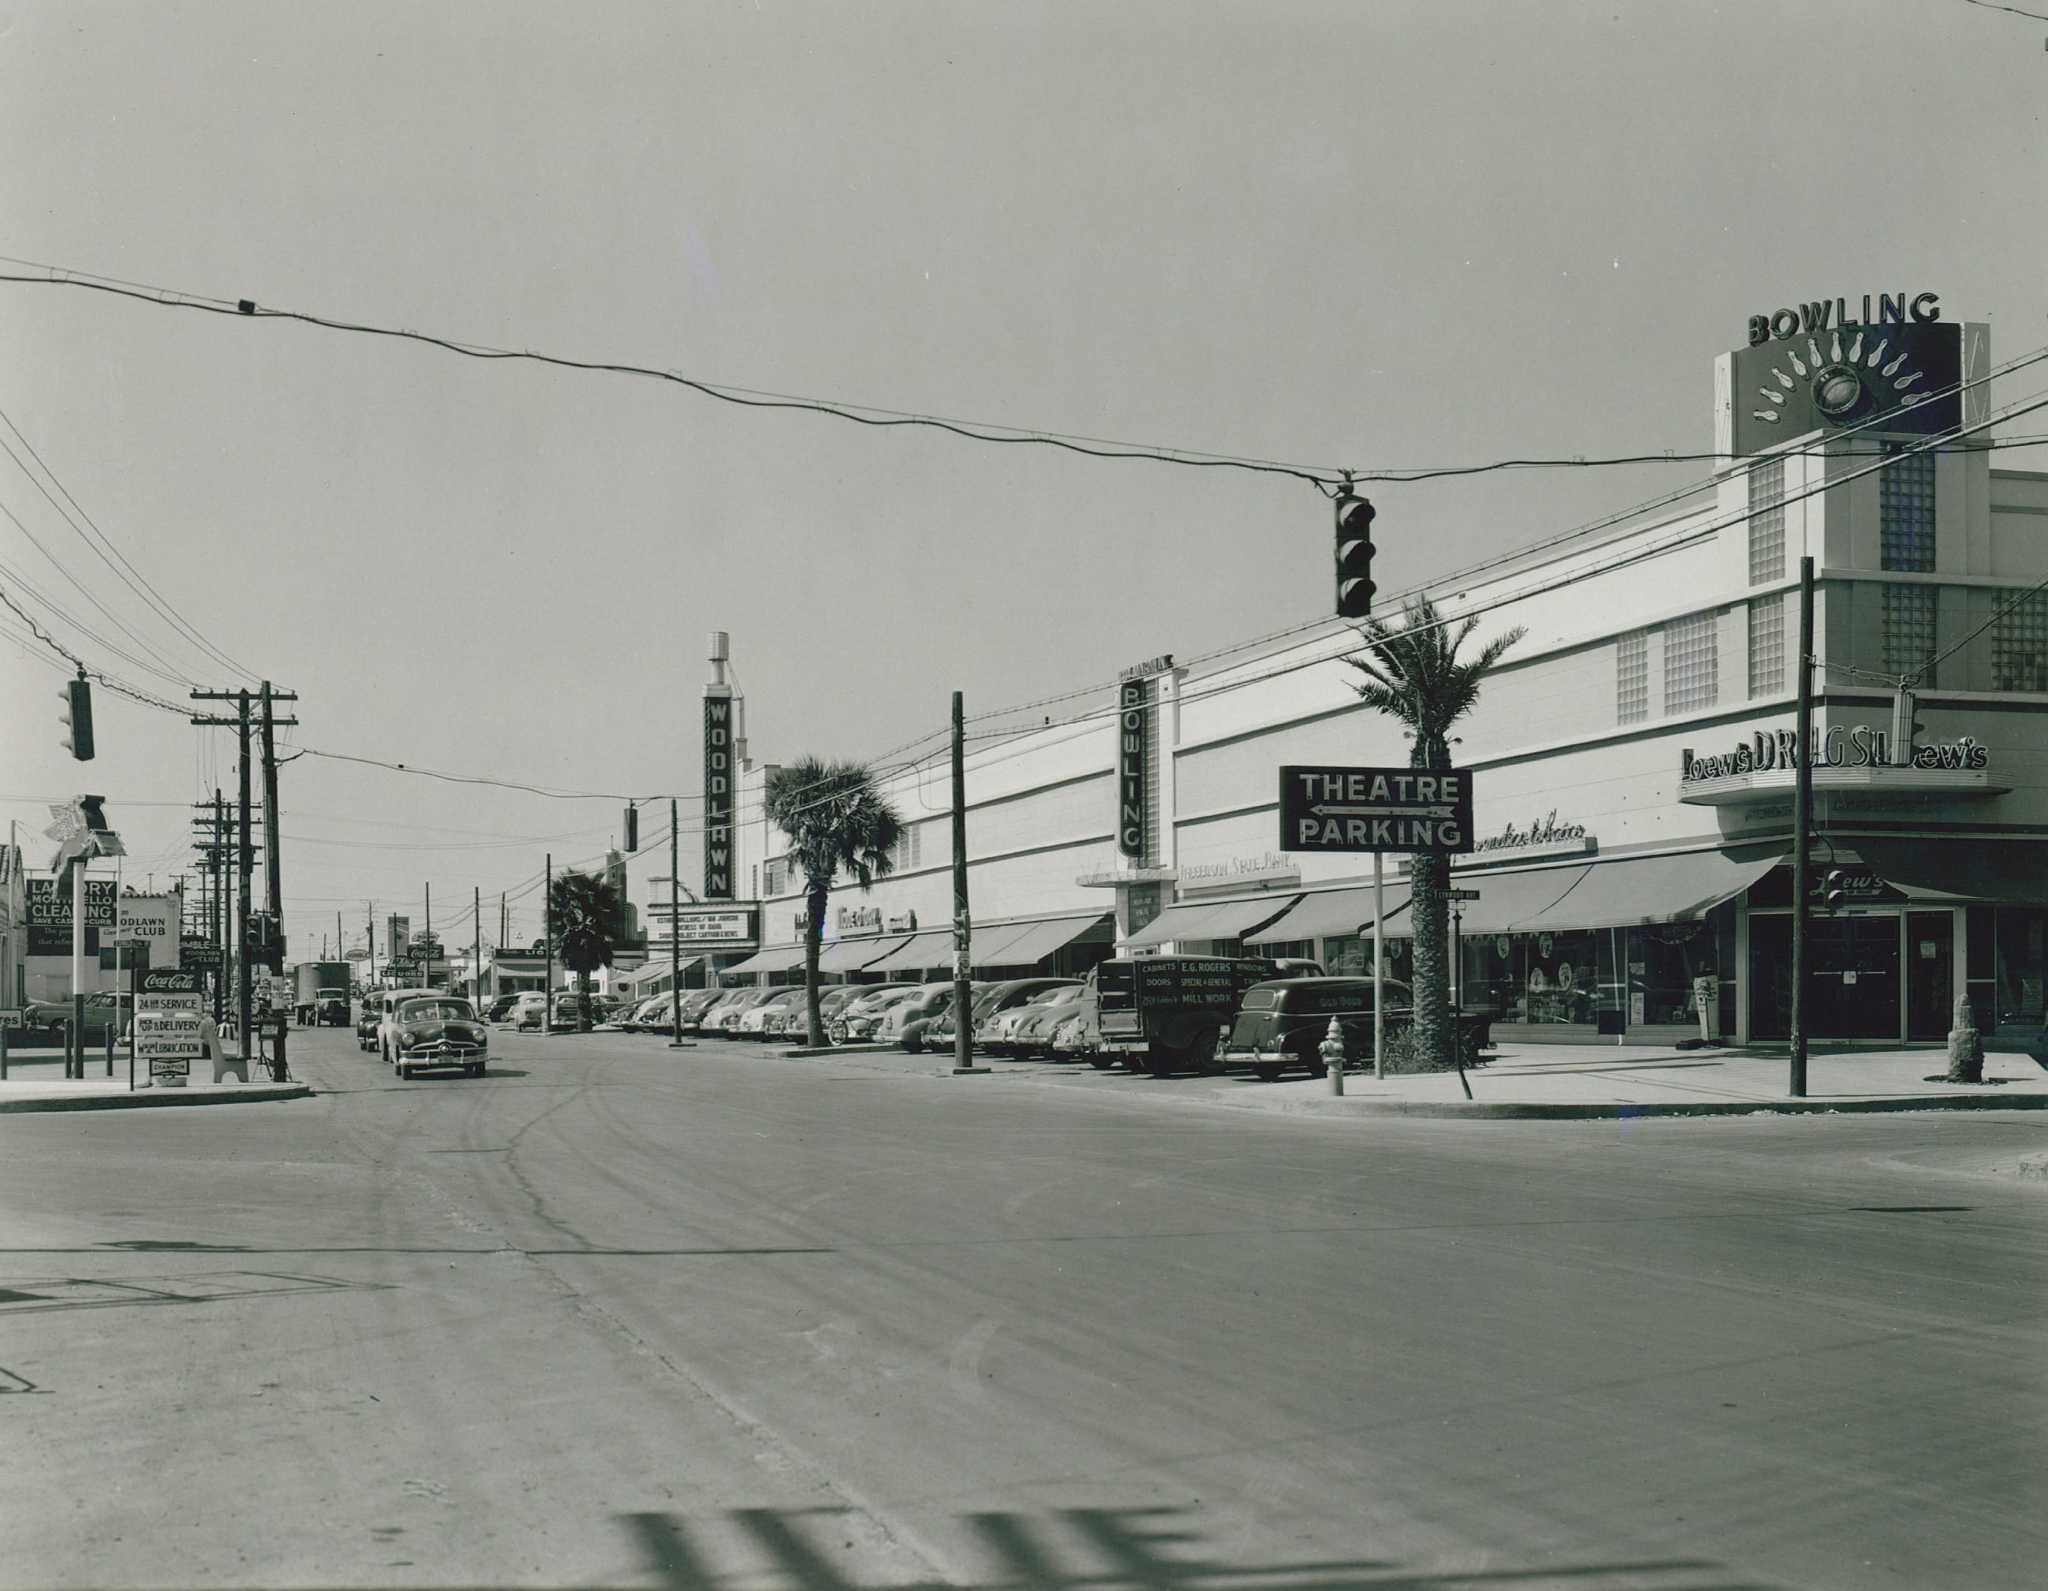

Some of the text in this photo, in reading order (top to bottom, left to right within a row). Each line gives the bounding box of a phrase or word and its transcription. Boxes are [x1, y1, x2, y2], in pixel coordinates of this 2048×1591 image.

[1749, 292, 1940, 347] BOWLING
[1872, 730, 1989, 768] Lew's
[1123, 687, 1141, 847] BOWLING
[710, 704, 727, 891] WOODLAWN
[1299, 774, 1460, 803] THEATRE
[1299, 818, 1461, 846] PARKING
[31, 881, 114, 895] LADRY
[1809, 873, 1885, 897] Lew's
[31, 905, 112, 918] CLEAING
[120, 918, 166, 927] ODLAWN
[134, 927, 166, 936] CLUB
[1199, 963, 1232, 972] ROGERS
[139, 1000, 149, 1010] 24
[160, 1000, 198, 1009] SERVICE
[159, 1021, 200, 1031] DELIVERY
